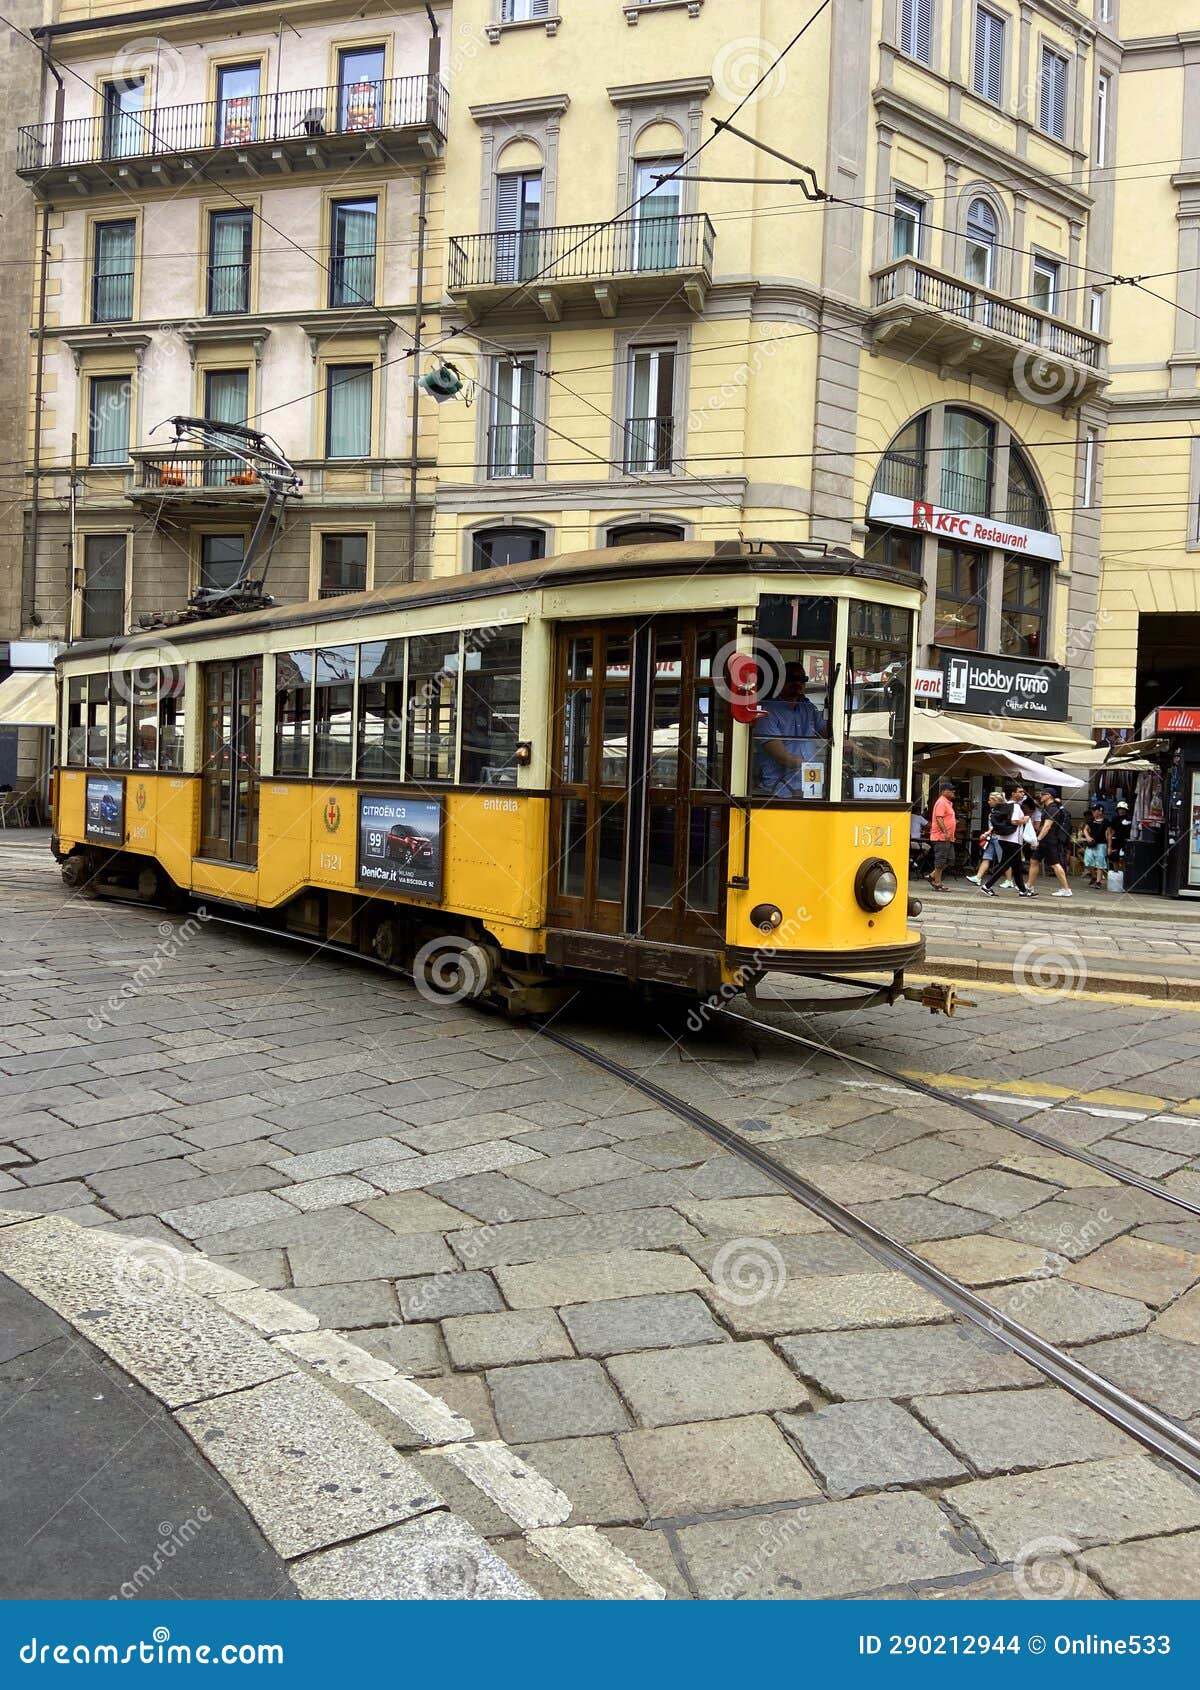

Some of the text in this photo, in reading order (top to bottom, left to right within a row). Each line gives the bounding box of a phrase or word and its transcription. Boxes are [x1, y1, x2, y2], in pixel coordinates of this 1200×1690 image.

[935, 513, 1028, 549] KFC Restaurant
[969, 667, 1049, 694] Hobby fumo
[808, 770, 816, 782] 9
[809, 783, 815, 796] 1
[858, 783, 866, 793] P.
[874, 783, 898, 793] DUOMO
[363, 805, 406, 818] CITROËN C3
[483, 798, 518, 812] entrata
[853, 825, 892, 848] 1521
[320, 853, 342, 870] 1521
[361, 865, 397, 881] DeniCar.it
